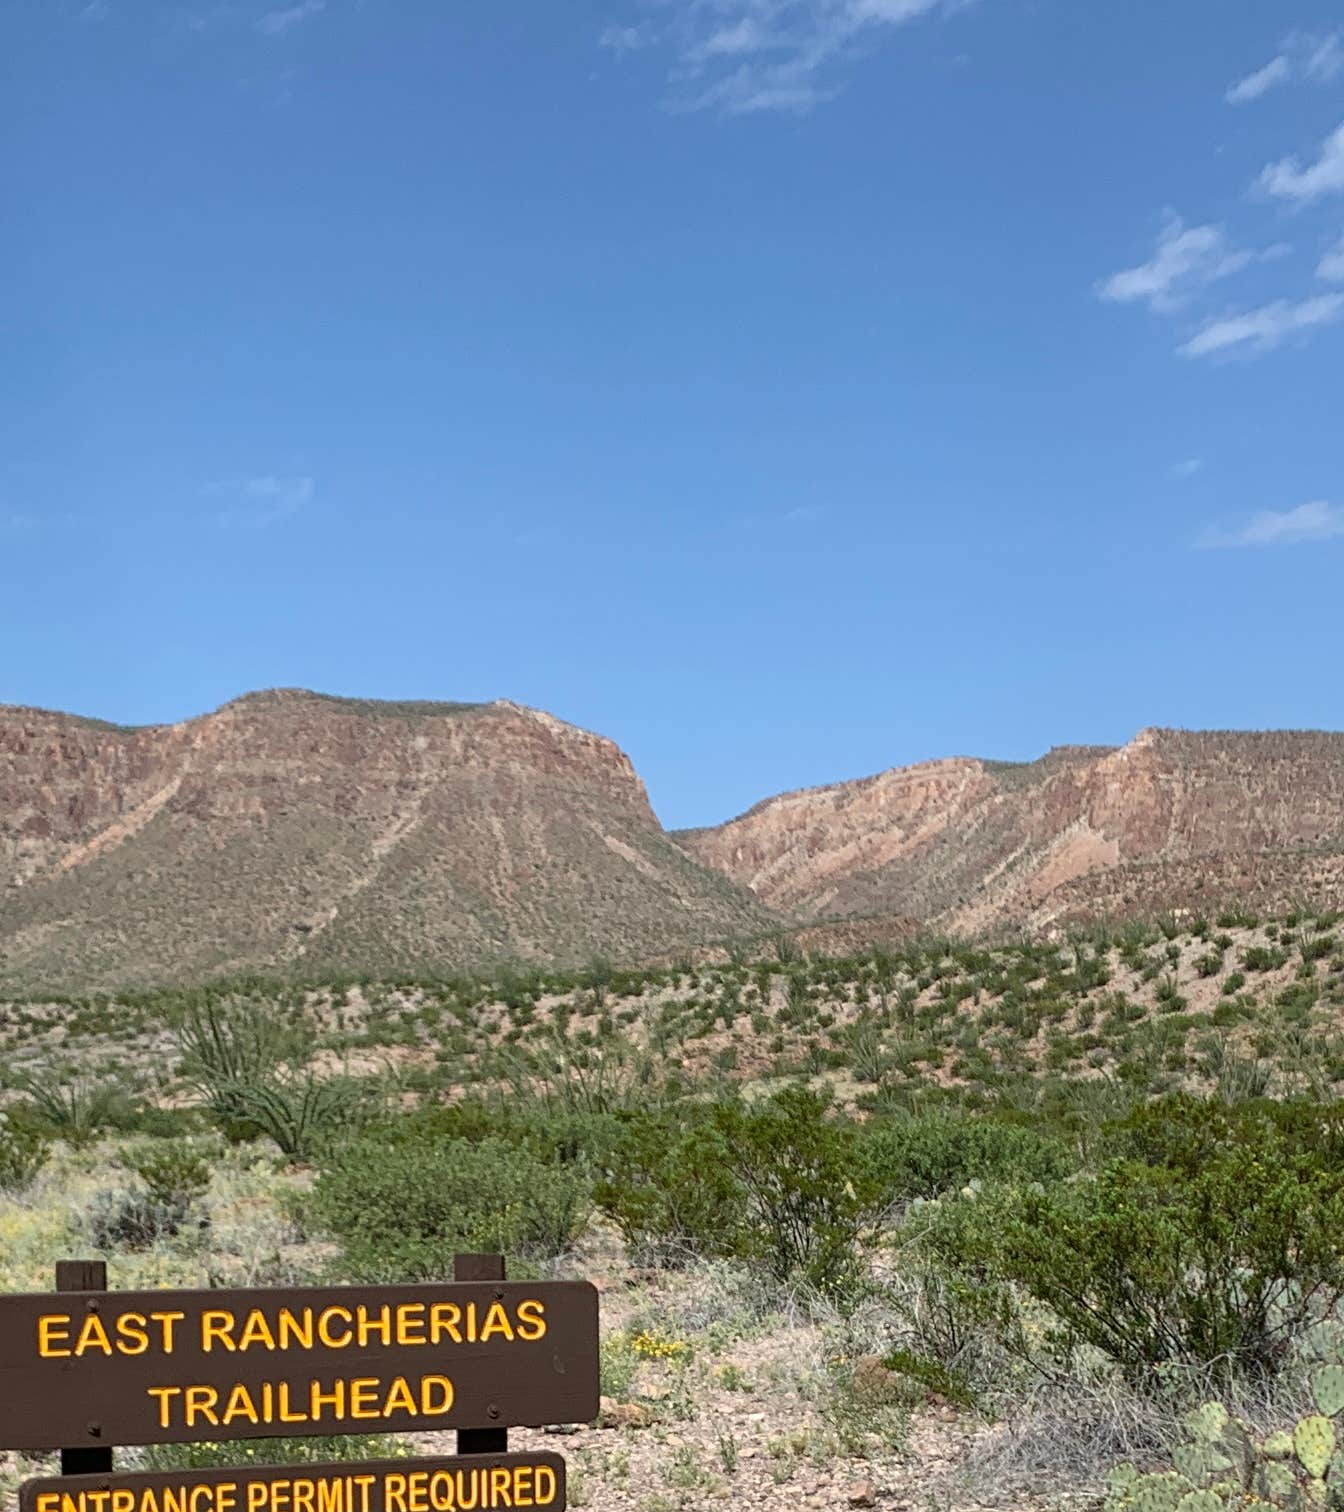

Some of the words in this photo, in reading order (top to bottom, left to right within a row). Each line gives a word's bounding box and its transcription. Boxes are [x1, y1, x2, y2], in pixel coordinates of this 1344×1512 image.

[39, 1312, 185, 1358] EAST
[203, 1301, 547, 1352] RANCHERIAS
[149, 1376, 454, 1427] TRAILHEAD
